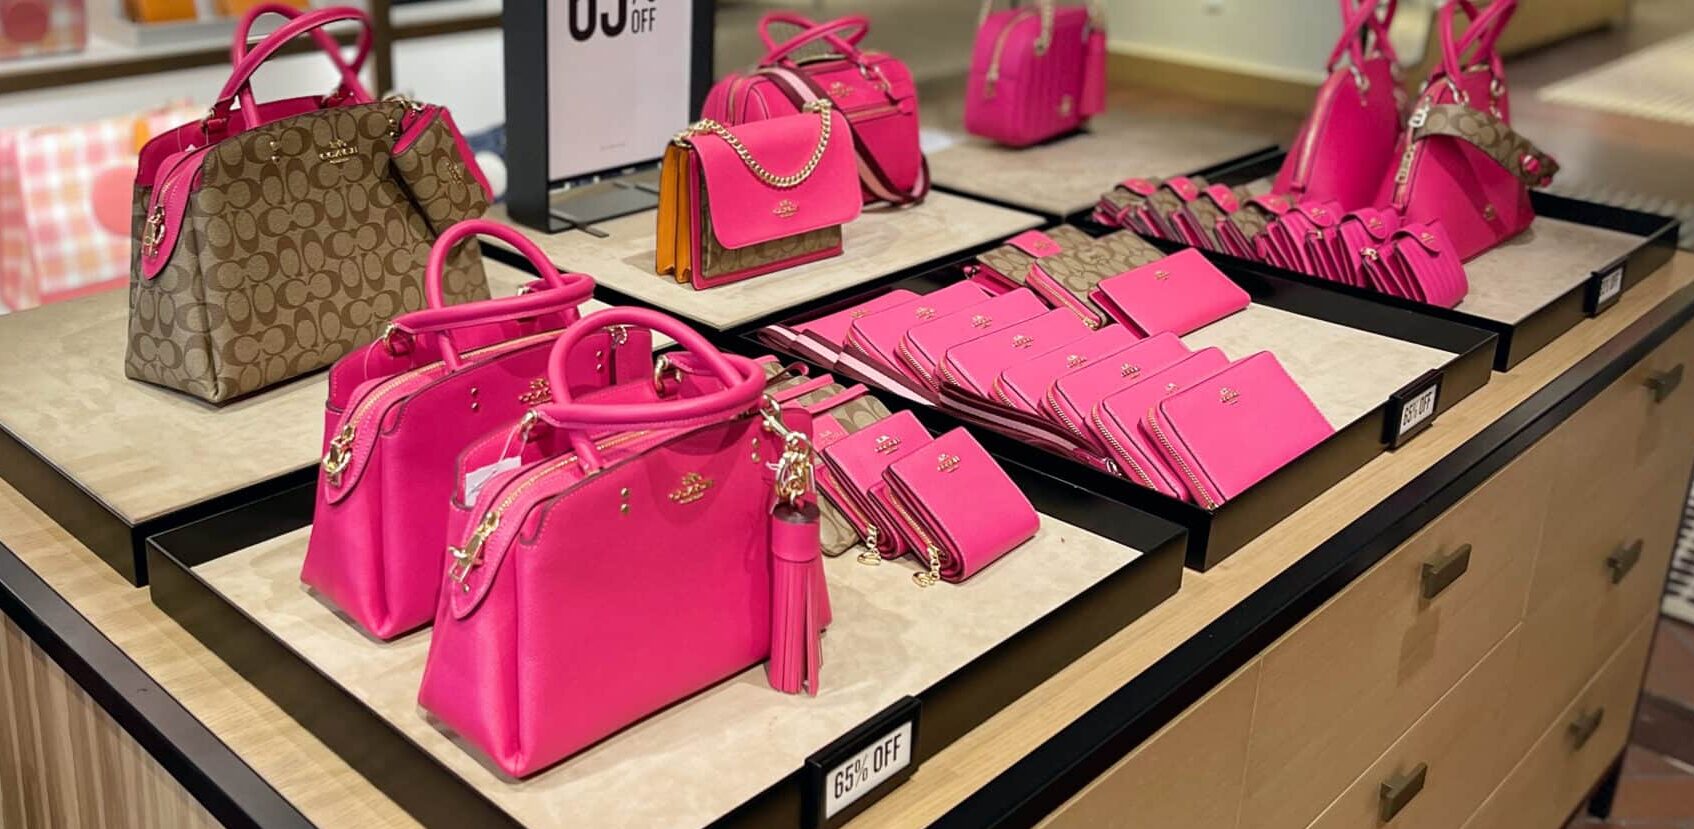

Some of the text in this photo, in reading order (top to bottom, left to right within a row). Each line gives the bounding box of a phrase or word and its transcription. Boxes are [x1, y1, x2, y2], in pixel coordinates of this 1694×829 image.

[631, 7, 656, 34] OFF
[833, 733, 902, 799] 65% OFF
